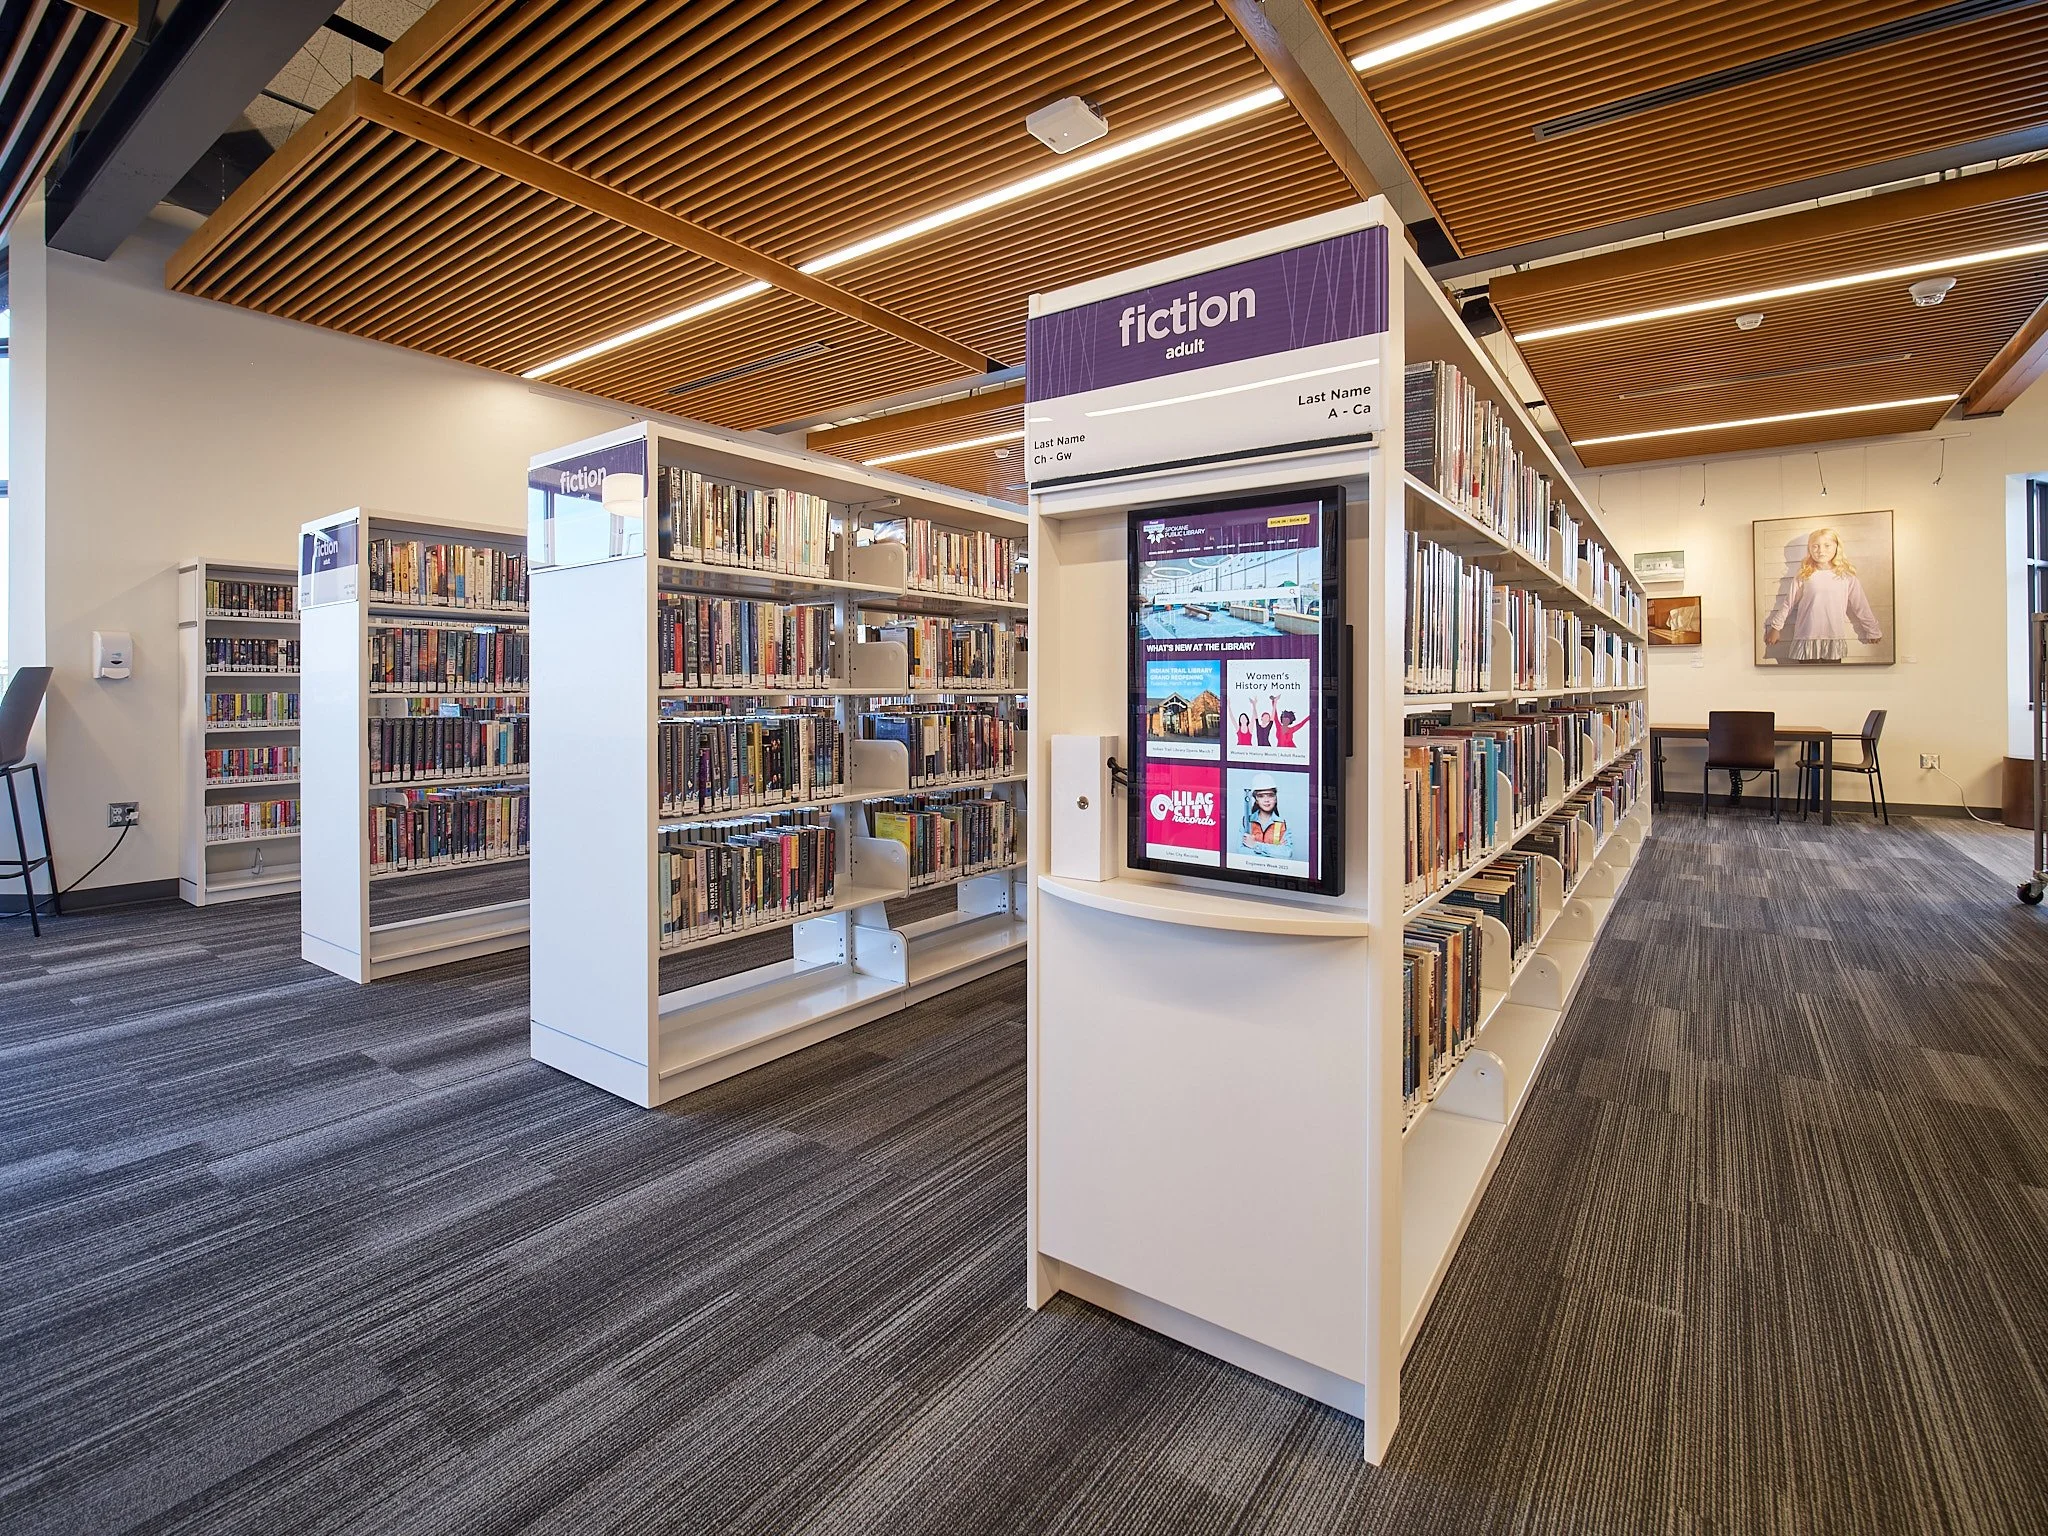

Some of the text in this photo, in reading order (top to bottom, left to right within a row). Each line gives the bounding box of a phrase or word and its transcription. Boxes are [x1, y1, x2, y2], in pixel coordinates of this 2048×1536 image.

[1119, 286, 1256, 347] fiction
[1165, 338, 1205, 360] adult
[1298, 384, 1371, 406] Last Name
[1328, 406, 1338, 419] A
[1353, 403, 1371, 416] Ca
[1034, 433, 1086, 450] Last Name
[1034, 455, 1047, 465] Ch
[1056, 451, 1072, 461] Gw
[560, 466, 607, 494] fiction
[1183, 529, 1206, 537] LIBRARY
[1174, 644, 1192, 652] NEW
[1192, 644, 1204, 652] AT
[1204, 643, 1220, 651] THE
[1220, 642, 1256, 650] LIBRARY
[1246, 672, 1290, 680] Women's
[1236, 682, 1301, 691] History Month
[1174, 790, 1214, 806] LILAC
[1174, 804, 1214, 818] CITY
[1172, 814, 1216, 826] records
